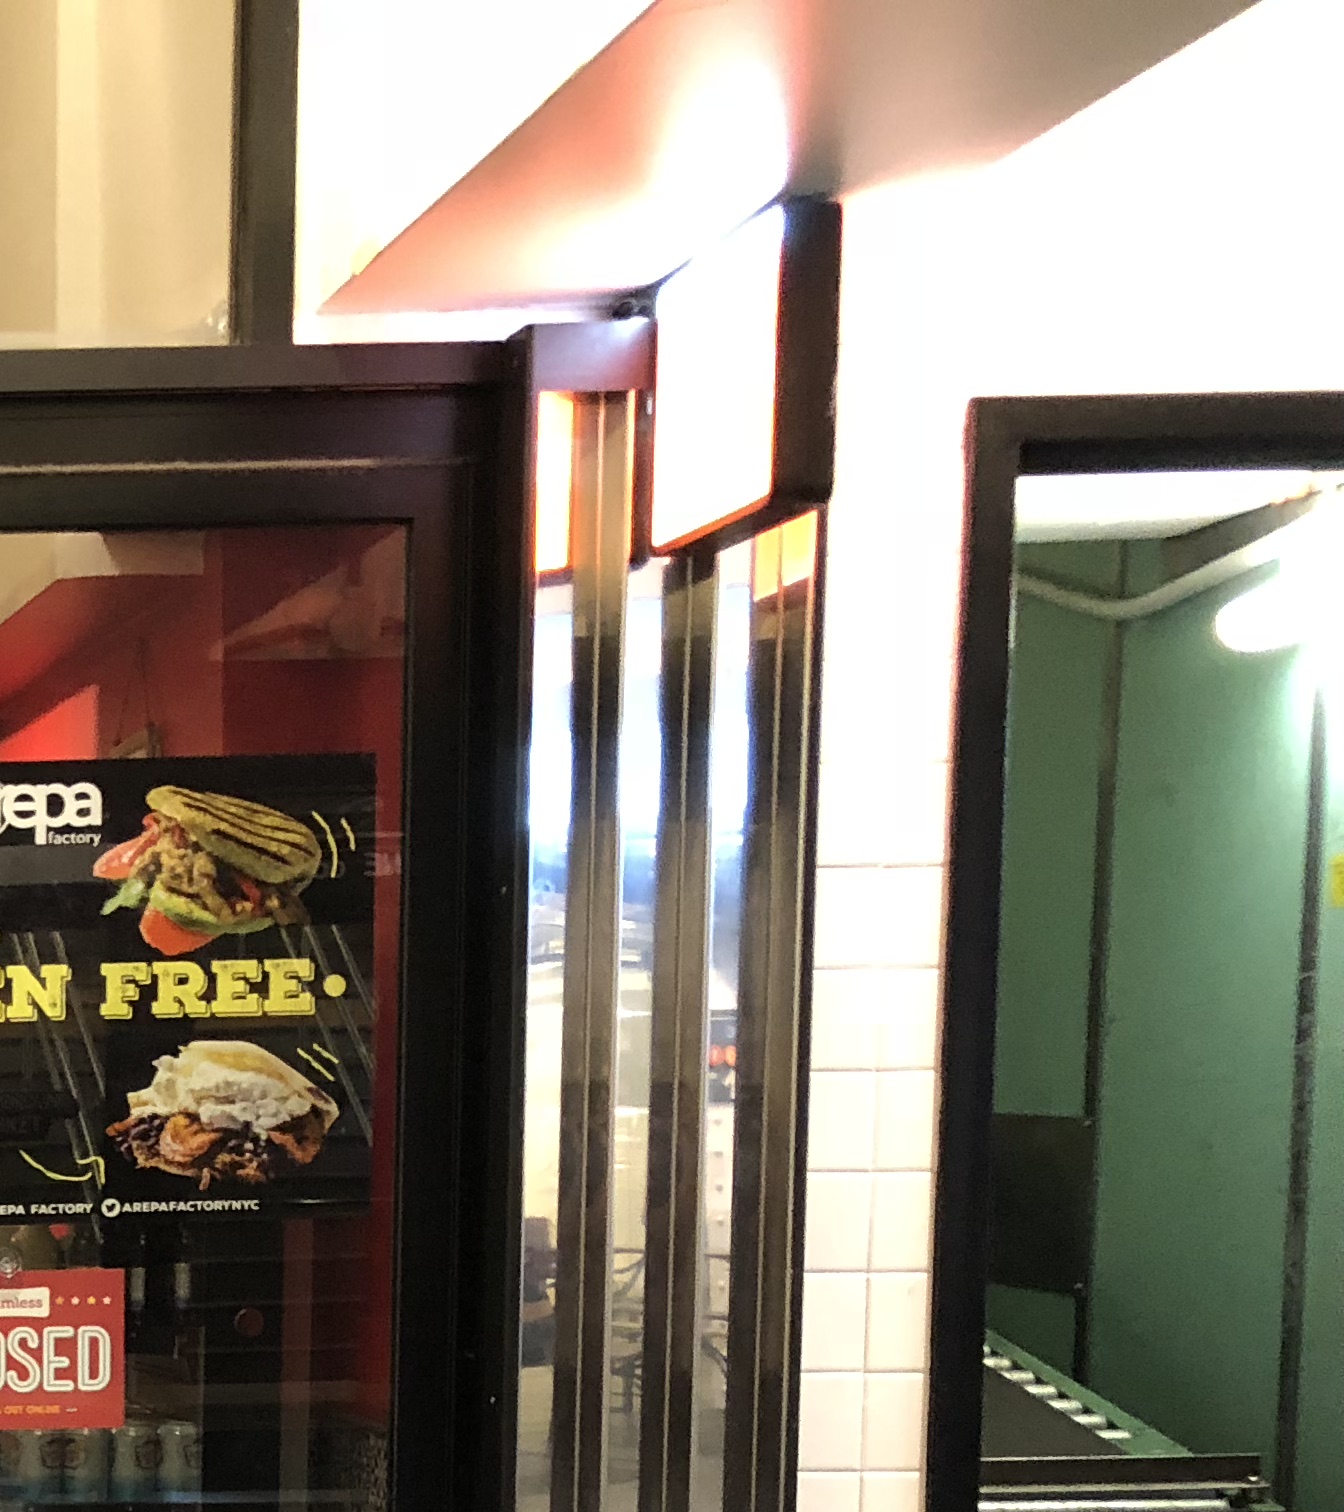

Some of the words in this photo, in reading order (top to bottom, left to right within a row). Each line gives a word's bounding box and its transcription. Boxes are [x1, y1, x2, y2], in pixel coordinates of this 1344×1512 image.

[47, 831, 102, 847] factory
[99, 958, 316, 1021] FREE
[30, 1203, 94, 1215] FACTORY
[121, 1200, 260, 1213] AREPAFACTORYNYC
